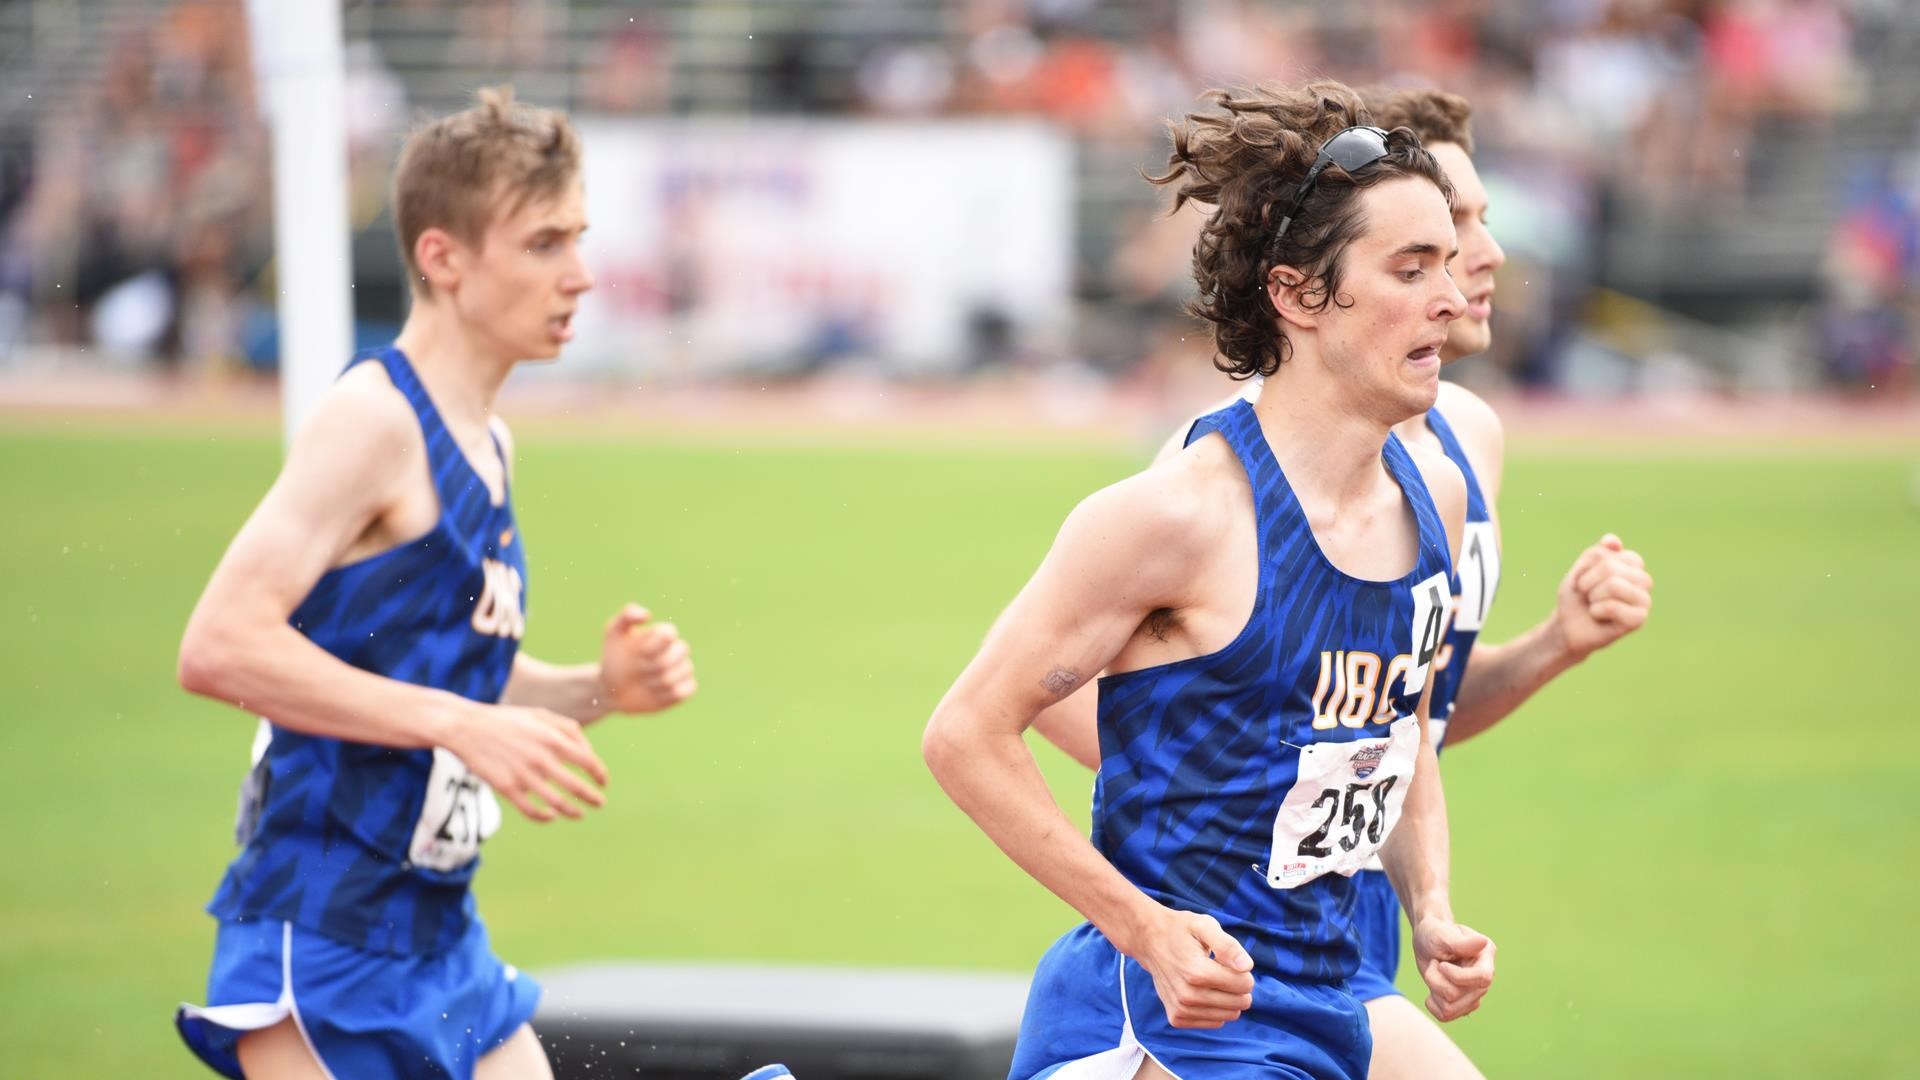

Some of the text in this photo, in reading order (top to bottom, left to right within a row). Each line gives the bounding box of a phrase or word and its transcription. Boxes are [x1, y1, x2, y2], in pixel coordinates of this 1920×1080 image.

[1468, 532, 1485, 622] 1
[1312, 650, 1411, 730] UBC
[1297, 775, 1397, 857] 258
